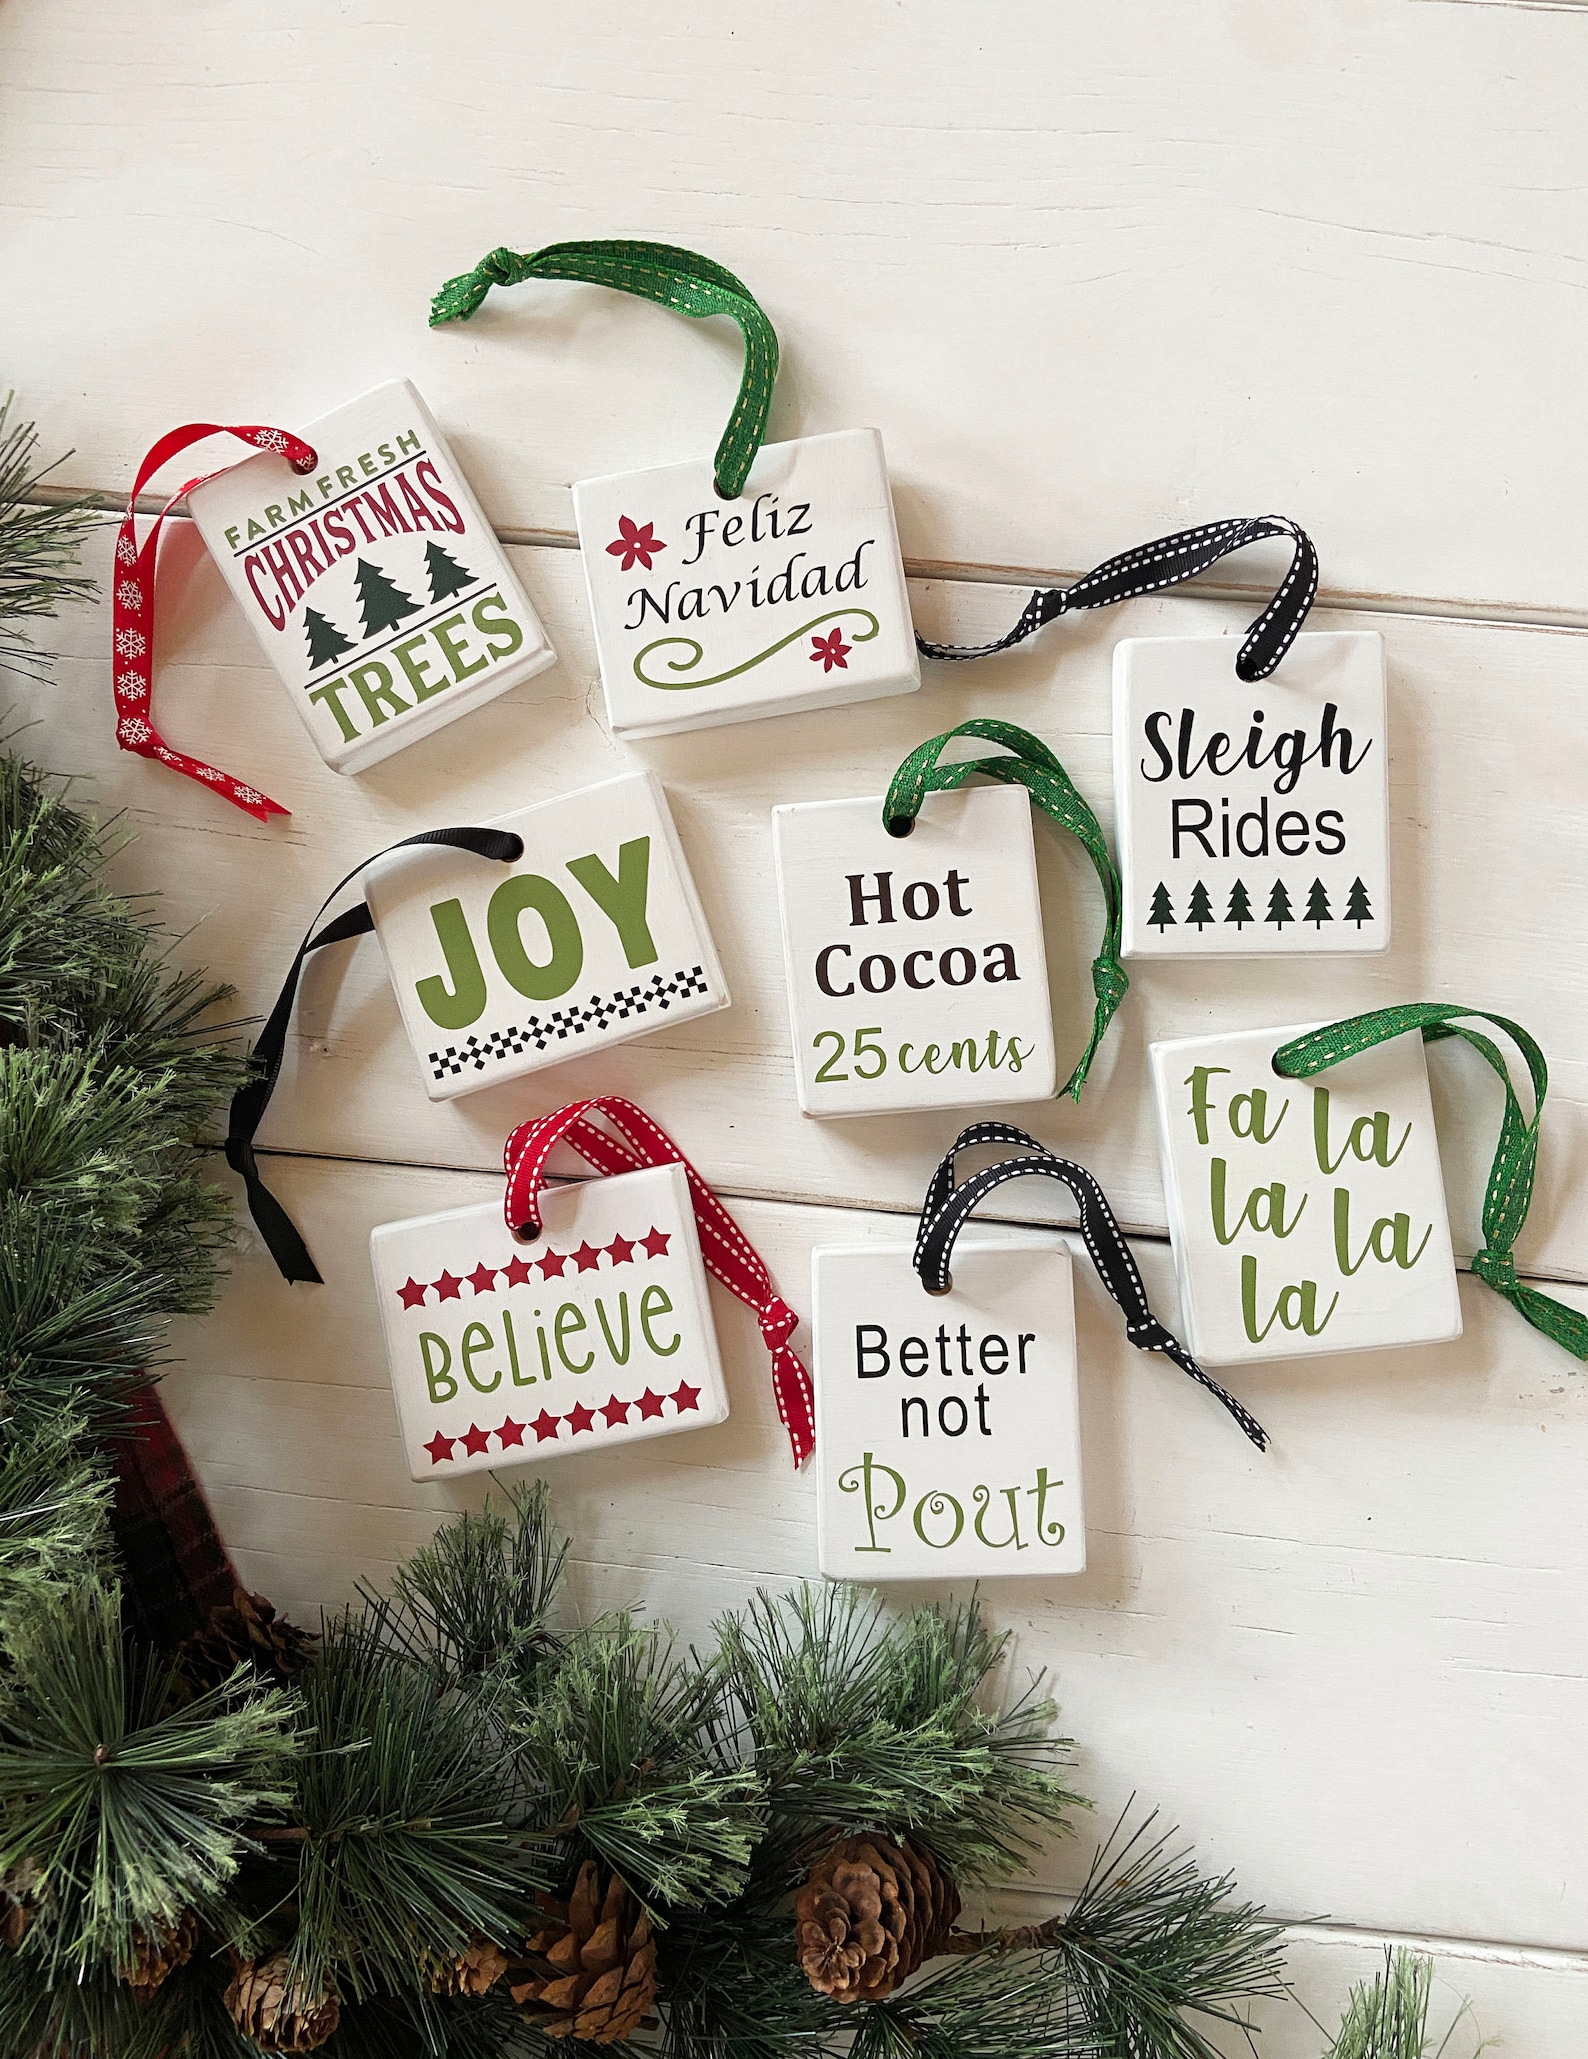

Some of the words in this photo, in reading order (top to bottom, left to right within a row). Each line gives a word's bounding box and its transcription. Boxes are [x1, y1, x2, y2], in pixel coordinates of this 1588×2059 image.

[244, 458, 466, 632] CHRISTMAS
[682, 493, 813, 565] Feliz
[623, 540, 876, 630] Navidad
[310, 592, 523, 743] TREES
[1140, 702, 1373, 795] Sleigh
[1171, 797, 1347, 860] Rides
[414, 835, 661, 1031] JOY
[845, 868, 973, 926] Hot
[815, 943, 1021, 998] Cocoa
[813, 1027, 888, 1084] 25
[899, 1030, 1036, 1076] cents
[1184, 1066, 1290, 1146] Fa
[1313, 1086, 1412, 1173] la
[1211, 1157, 1309, 1246] la
[1332, 1187, 1433, 1276] la
[1240, 1255, 1339, 1344] la
[856, 1324, 1036, 1379] Better
[901, 1382, 993, 1438] not
[838, 1452, 1066, 1554] Pout
